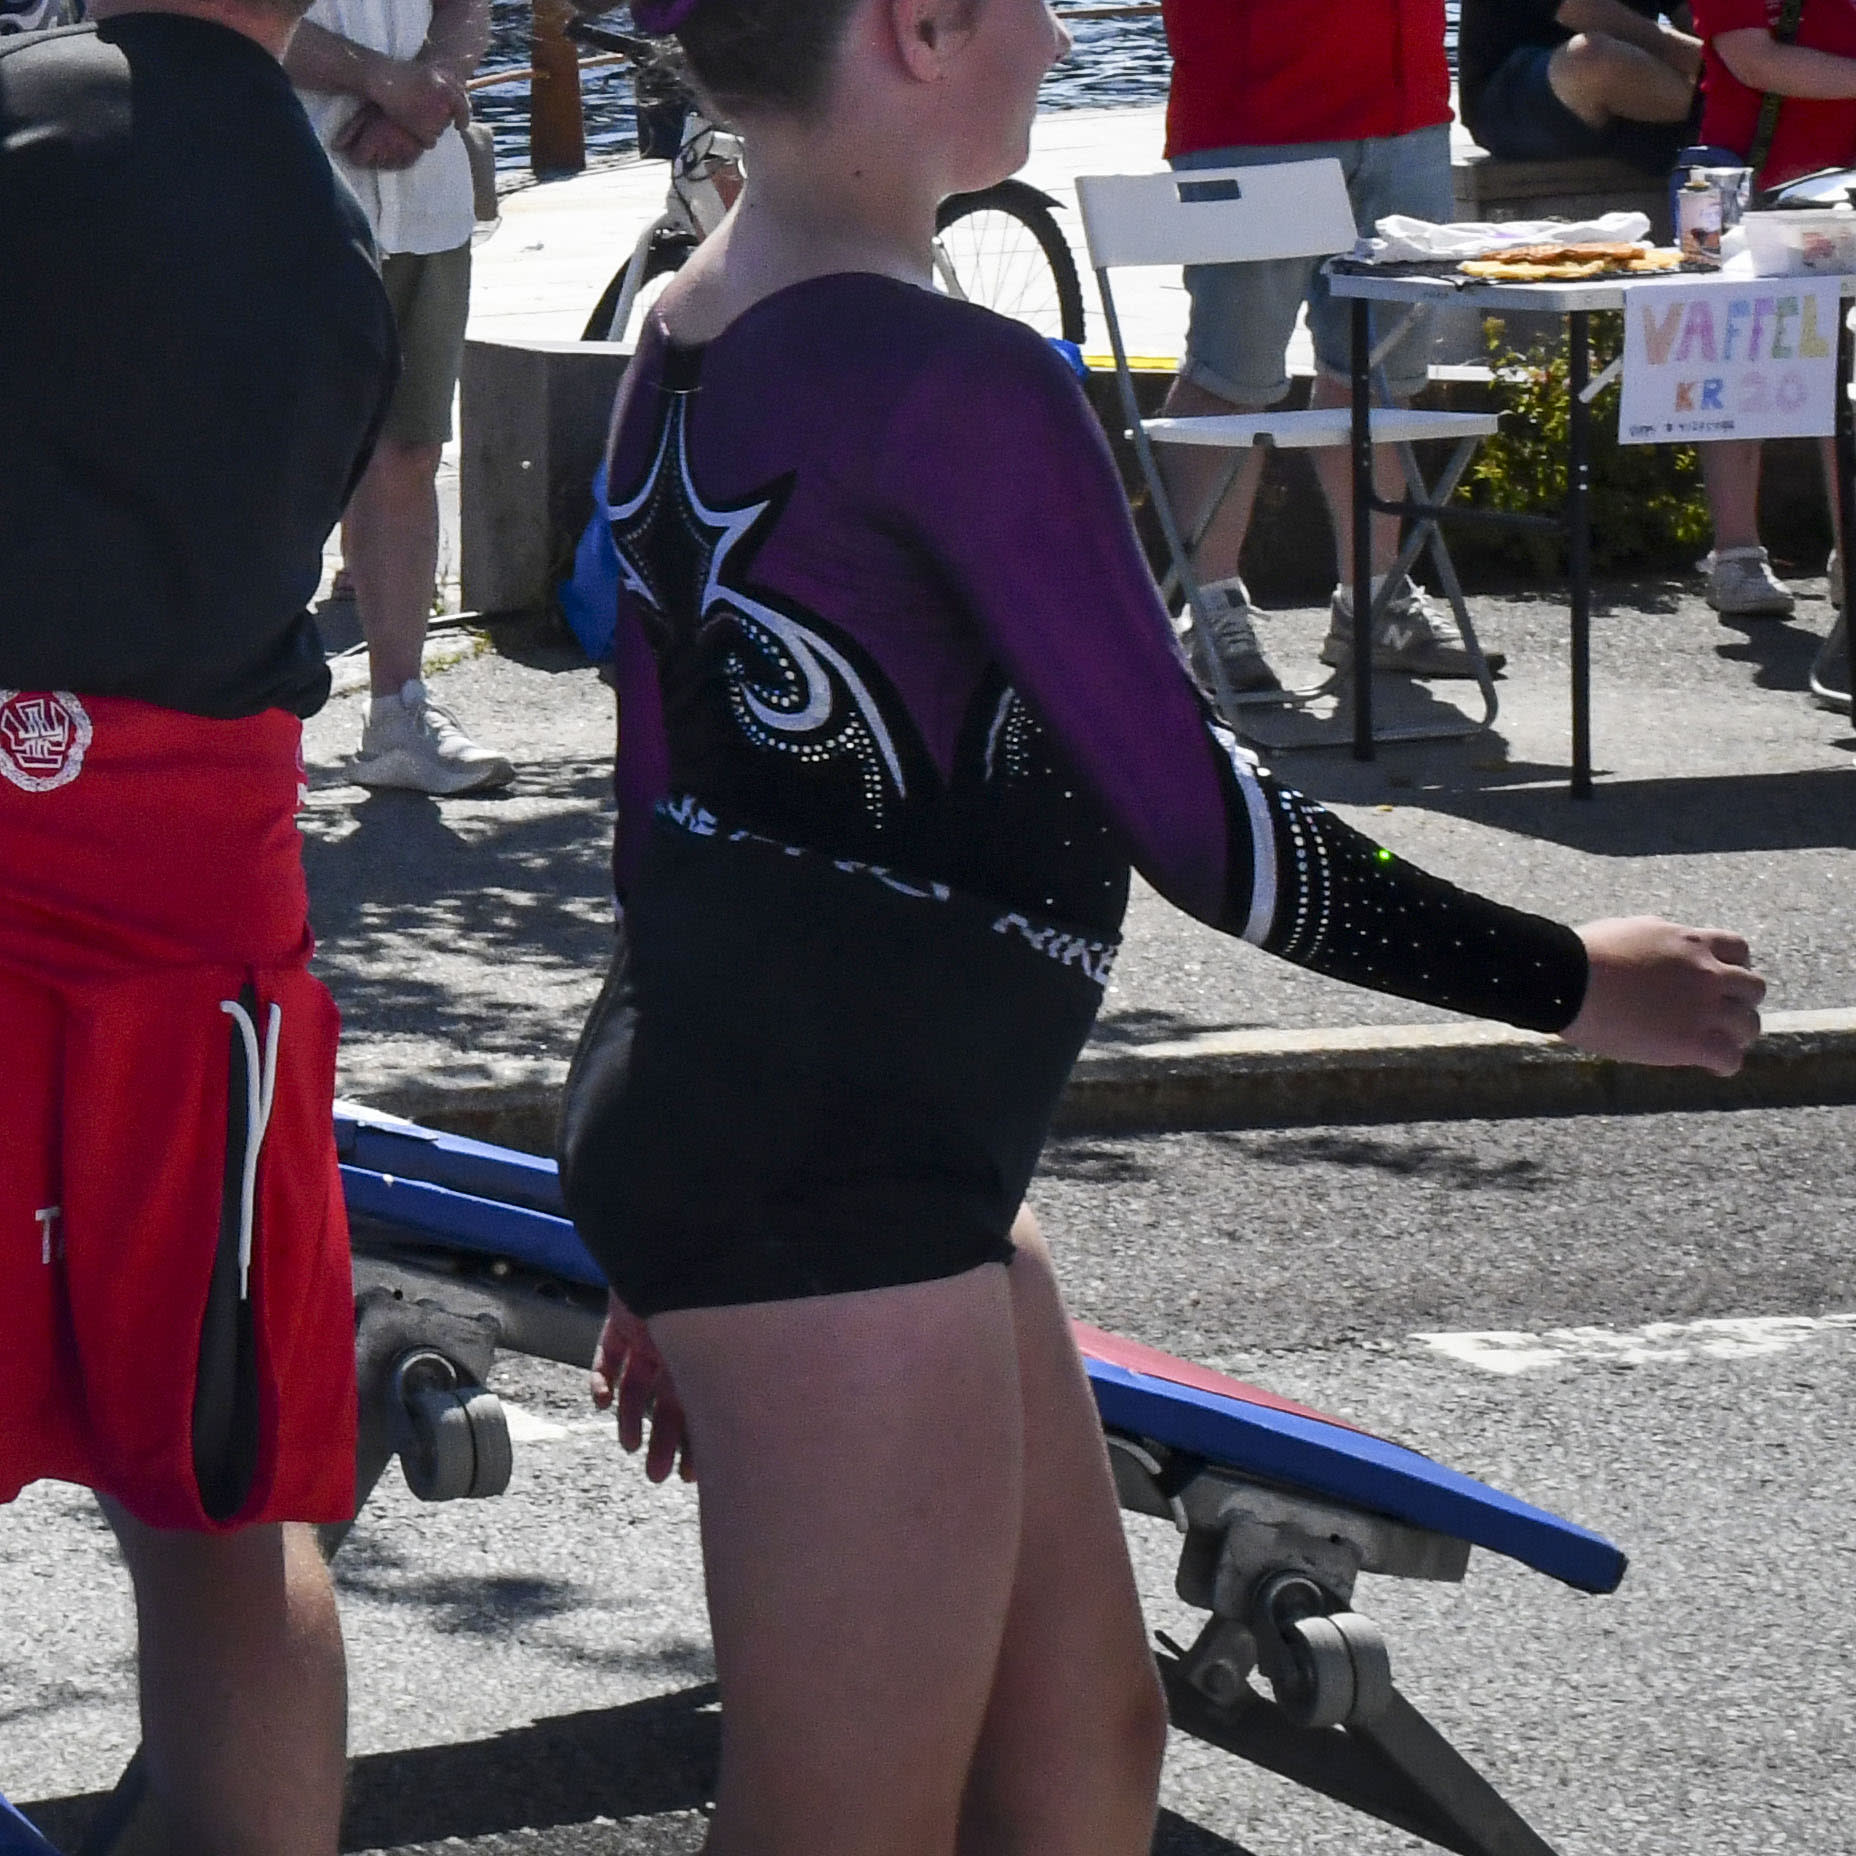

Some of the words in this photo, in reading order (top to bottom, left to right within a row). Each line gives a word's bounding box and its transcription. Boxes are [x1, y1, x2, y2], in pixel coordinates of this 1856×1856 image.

[1642, 294, 1830, 366] VAFFEL
[1675, 378, 1724, 412] KR
[1741, 371, 1809, 414] 20
